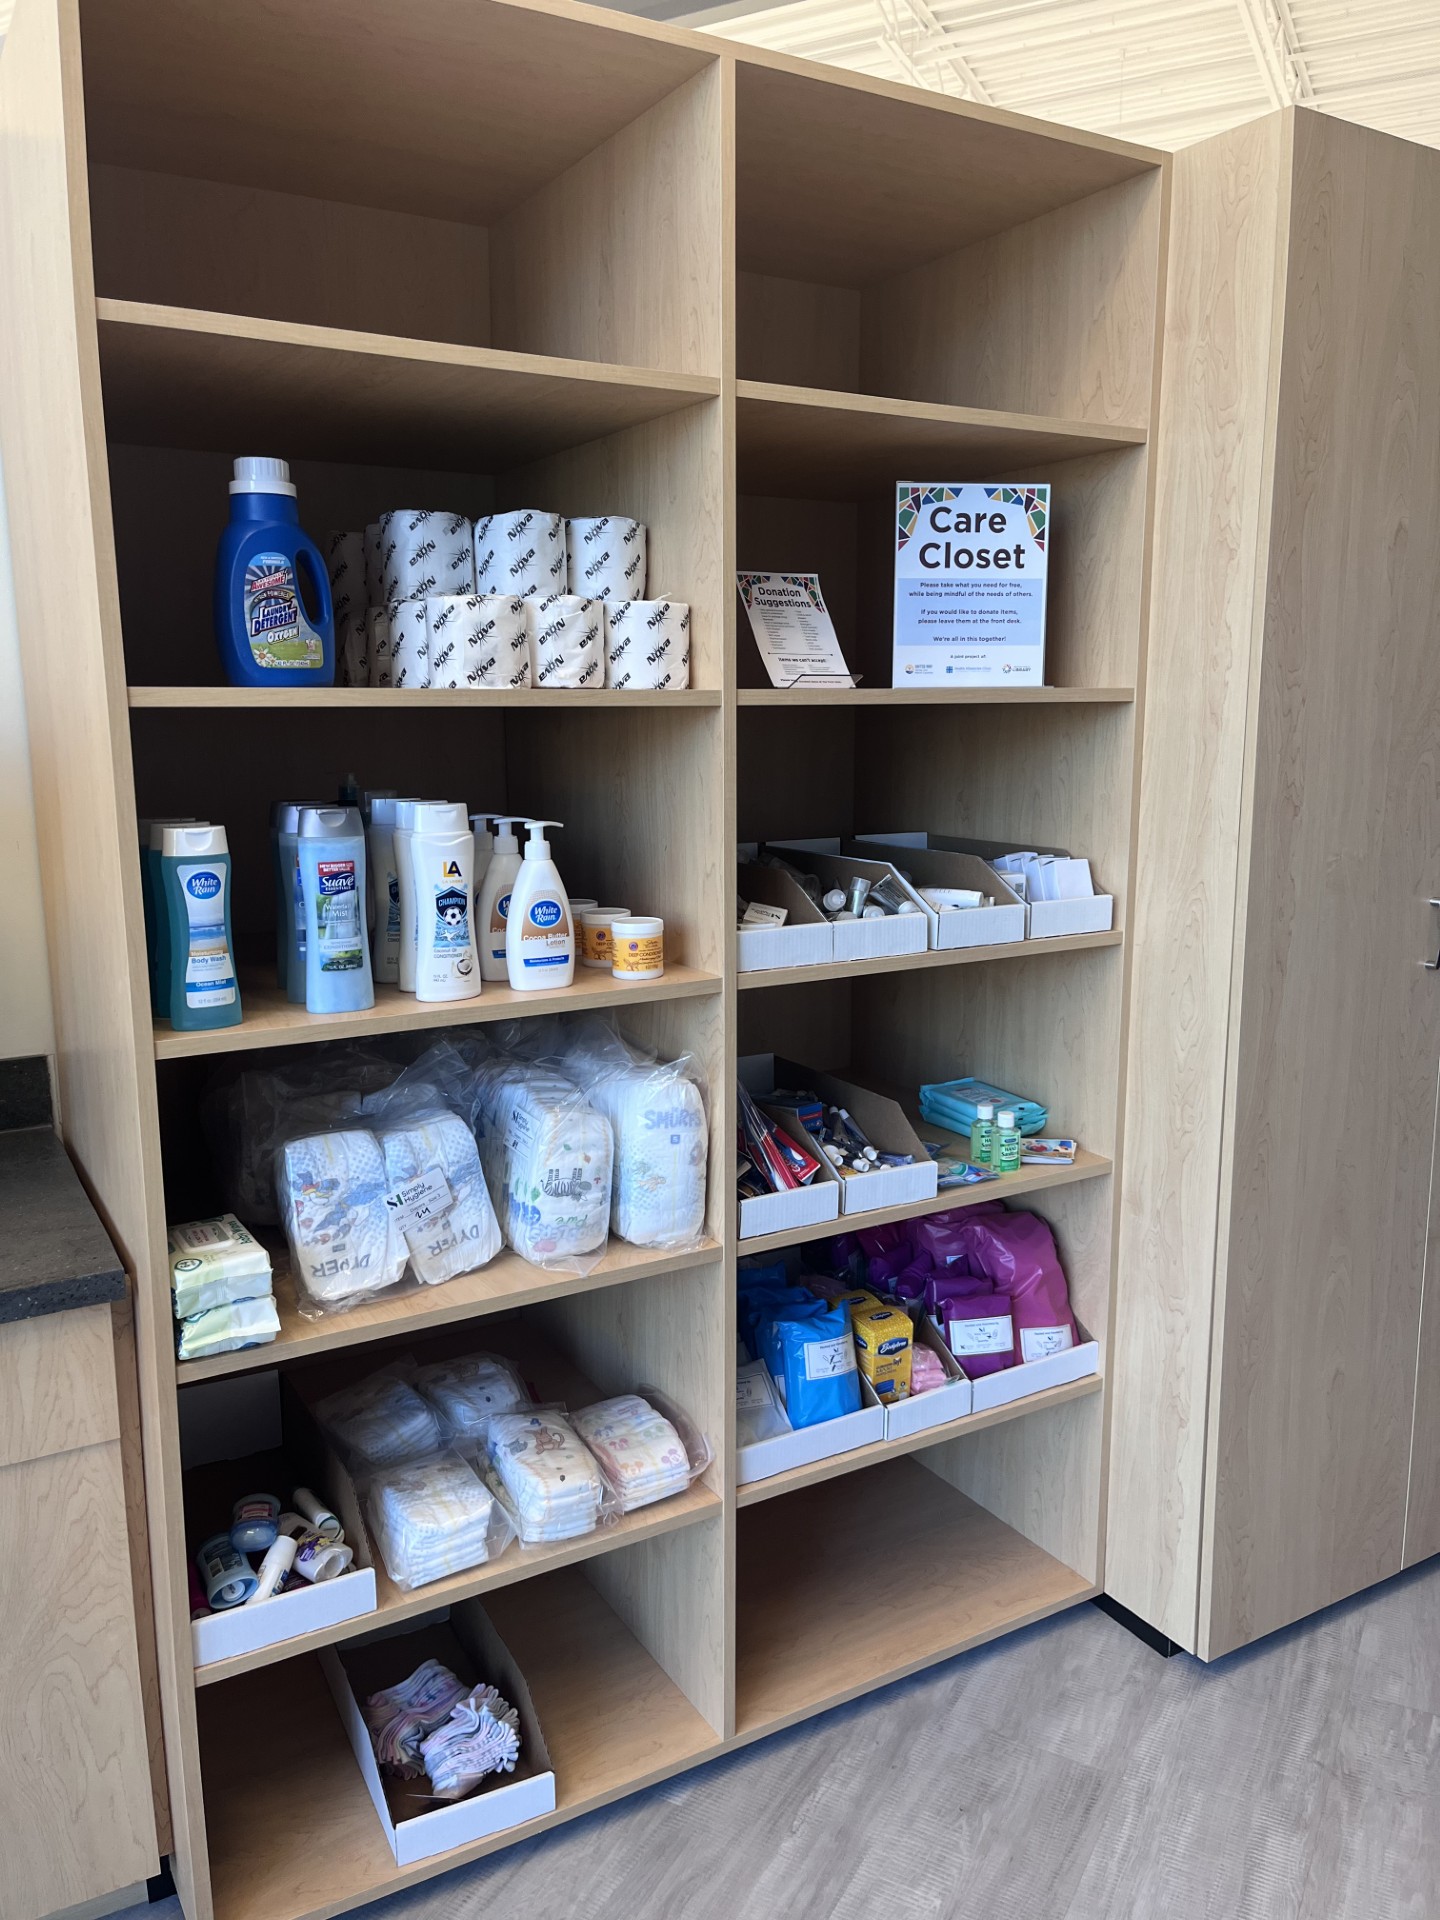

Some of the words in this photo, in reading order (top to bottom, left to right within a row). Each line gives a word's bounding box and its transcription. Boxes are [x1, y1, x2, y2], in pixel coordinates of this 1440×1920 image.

[507, 513, 534, 541] Nova
[583, 517, 610, 544] Nova
[930, 506, 1007, 533] Care
[623, 522, 641, 545] Nova
[409, 539, 436, 566] Nova
[478, 549, 495, 578] Nova
[509, 548, 536, 577] Nova
[585, 552, 611, 580] Nova
[919, 542, 1025, 569] Closet
[624, 554, 641, 580] Nova
[251, 575, 285, 592] AWESOME
[758, 587, 801, 597] Donation
[262, 603, 292, 619] LAUNDRY
[609, 602, 631, 629] Nova
[754, 597, 812, 608] Suggestions
[252, 610, 297, 634] DETERGENT
[433, 604, 455, 633] Nova
[646, 603, 671, 630] Nova
[267, 628, 299, 644] OXYGEN
[468, 619, 496, 648] Nova
[538, 618, 566, 645] Nova
[391, 632, 405, 660] Nova
[433, 642, 455, 671] Nova
[609, 636, 632, 665] Nova
[646, 638, 671, 666] Nova
[467, 657, 496, 683] Nova
[510, 661, 529, 688] Nova
[538, 654, 565, 682] Nova
[322, 875, 354, 888] Suave
[443, 860, 462, 877] LA
[191, 878, 218, 888] White
[193, 886, 216, 895] Rain
[438, 897, 466, 907] CHAMPION
[535, 906, 558, 915] White
[536, 914, 556, 923] Rain
[191, 957, 209, 965] Body
[210, 955, 227, 963] Wash
[402, 1182, 425, 1197] Simply
[404, 1185, 432, 1203] Hygiene
[428, 1224, 479, 1256] DYPER
